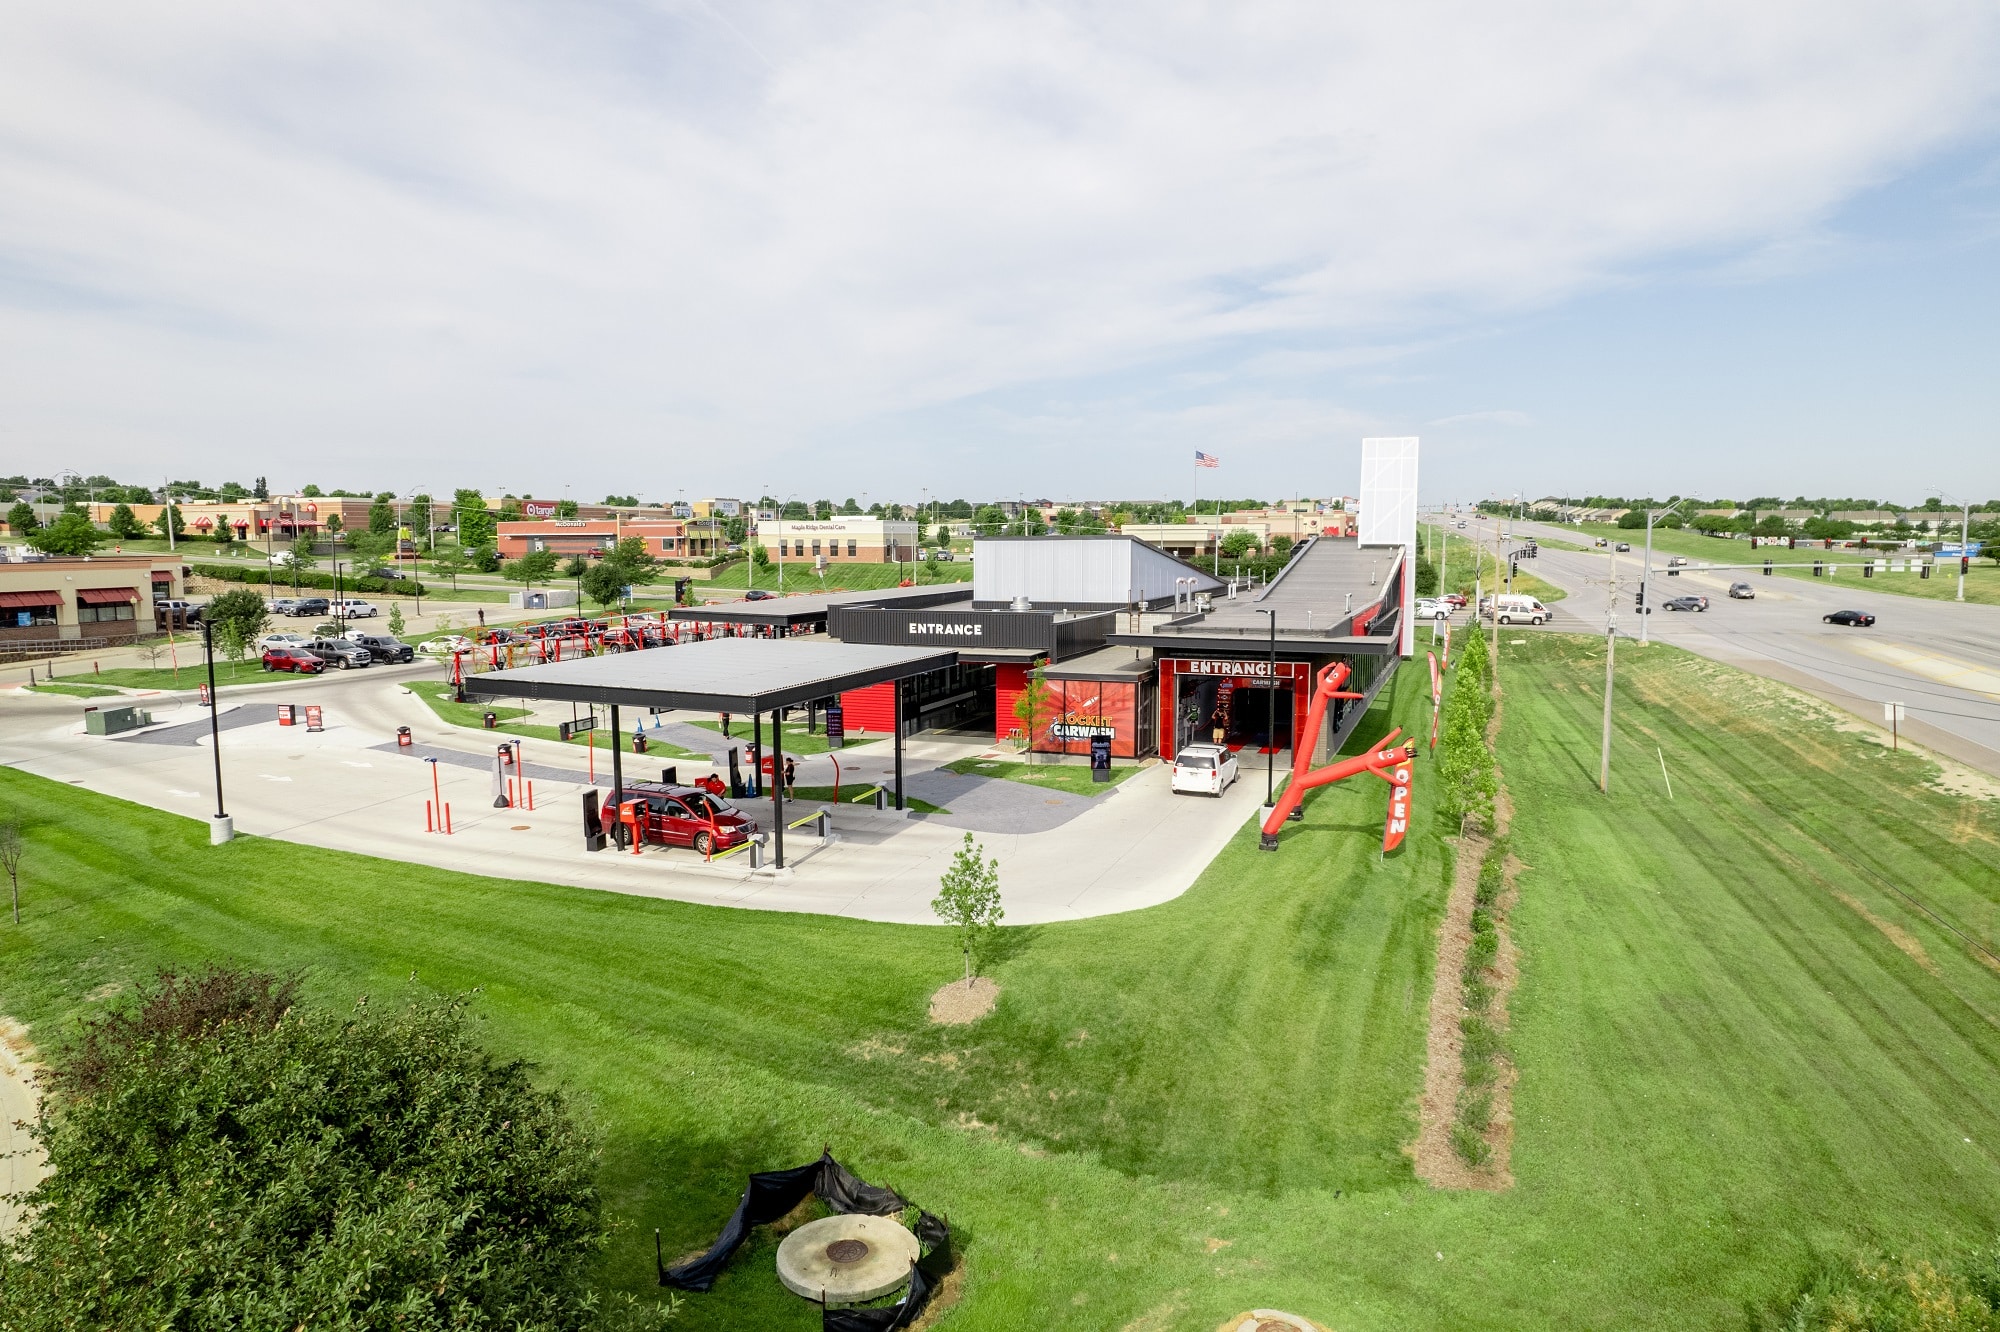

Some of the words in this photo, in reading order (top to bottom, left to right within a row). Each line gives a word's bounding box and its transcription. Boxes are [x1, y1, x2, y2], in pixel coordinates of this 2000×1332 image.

[535, 504, 556, 517] target
[909, 622, 982, 636] ENTRANCE
[1190, 661, 1277, 675] ENTRANCE
[1053, 724, 1116, 739] CARWASH
[1390, 769, 1409, 834] OPEN
